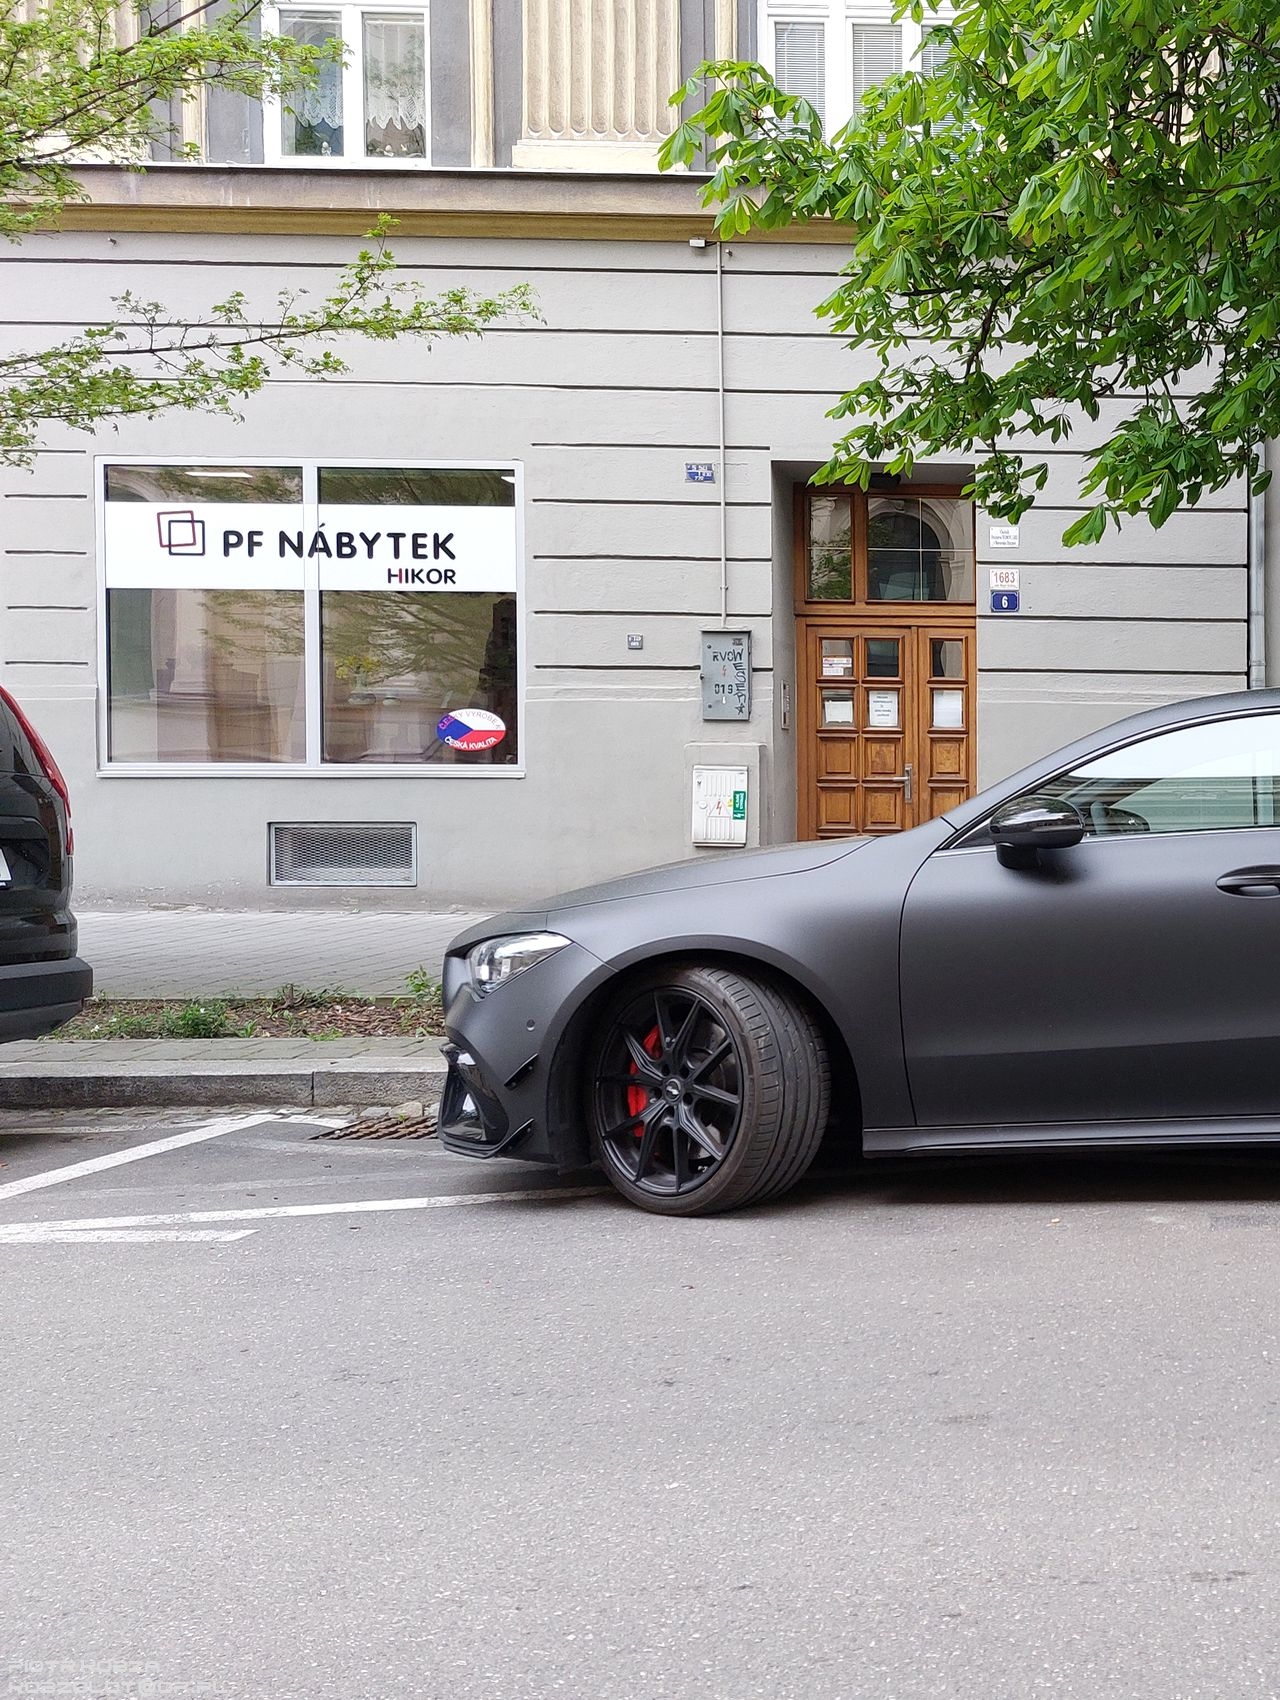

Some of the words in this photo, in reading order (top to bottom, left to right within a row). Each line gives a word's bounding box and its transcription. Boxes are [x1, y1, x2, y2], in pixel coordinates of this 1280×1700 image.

[222, 530, 264, 558] PF
[278, 523, 456, 561] NÁBYTEK
[387, 568, 457, 585] HIKOR
[994, 571, 1016, 584] 1683
[1002, 595, 1009, 608] 6
[468, 737, 497, 750] KVALITA
